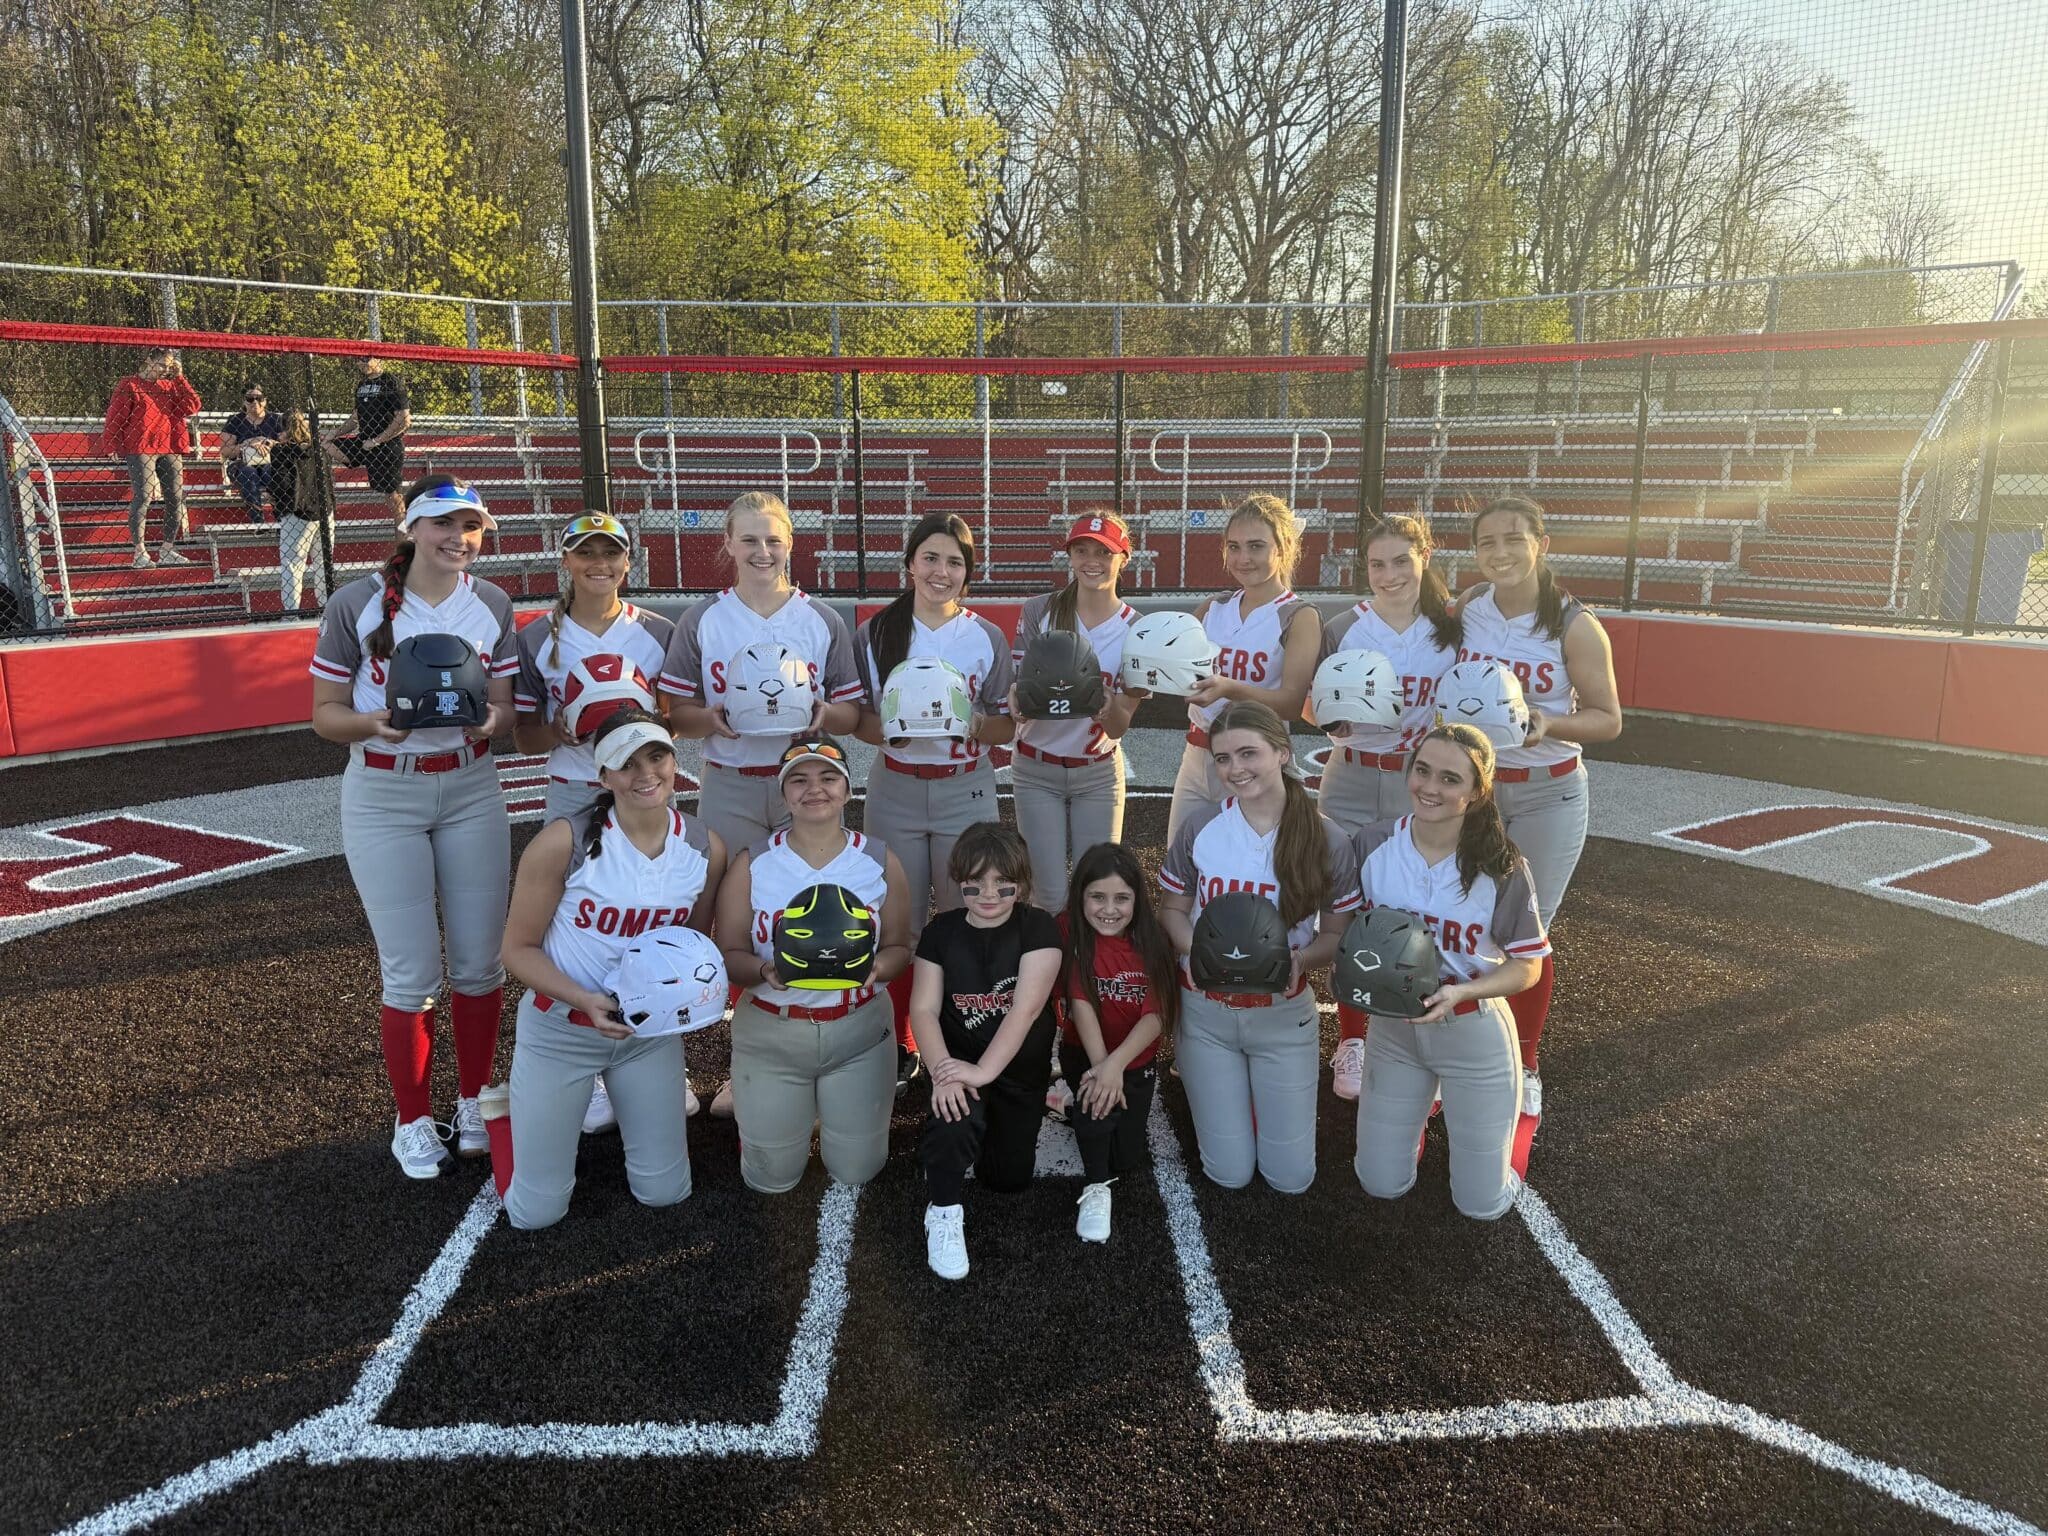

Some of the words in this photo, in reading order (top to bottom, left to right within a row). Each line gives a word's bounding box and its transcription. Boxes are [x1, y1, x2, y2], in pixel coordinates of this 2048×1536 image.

[1090, 518, 1102, 531] S
[1131, 658, 1140, 669] 21
[1334, 689, 1340, 700] 9
[1049, 700, 1070, 714] 22
[574, 898, 689, 938] SOMER
[1353, 988, 1371, 1005] 24
